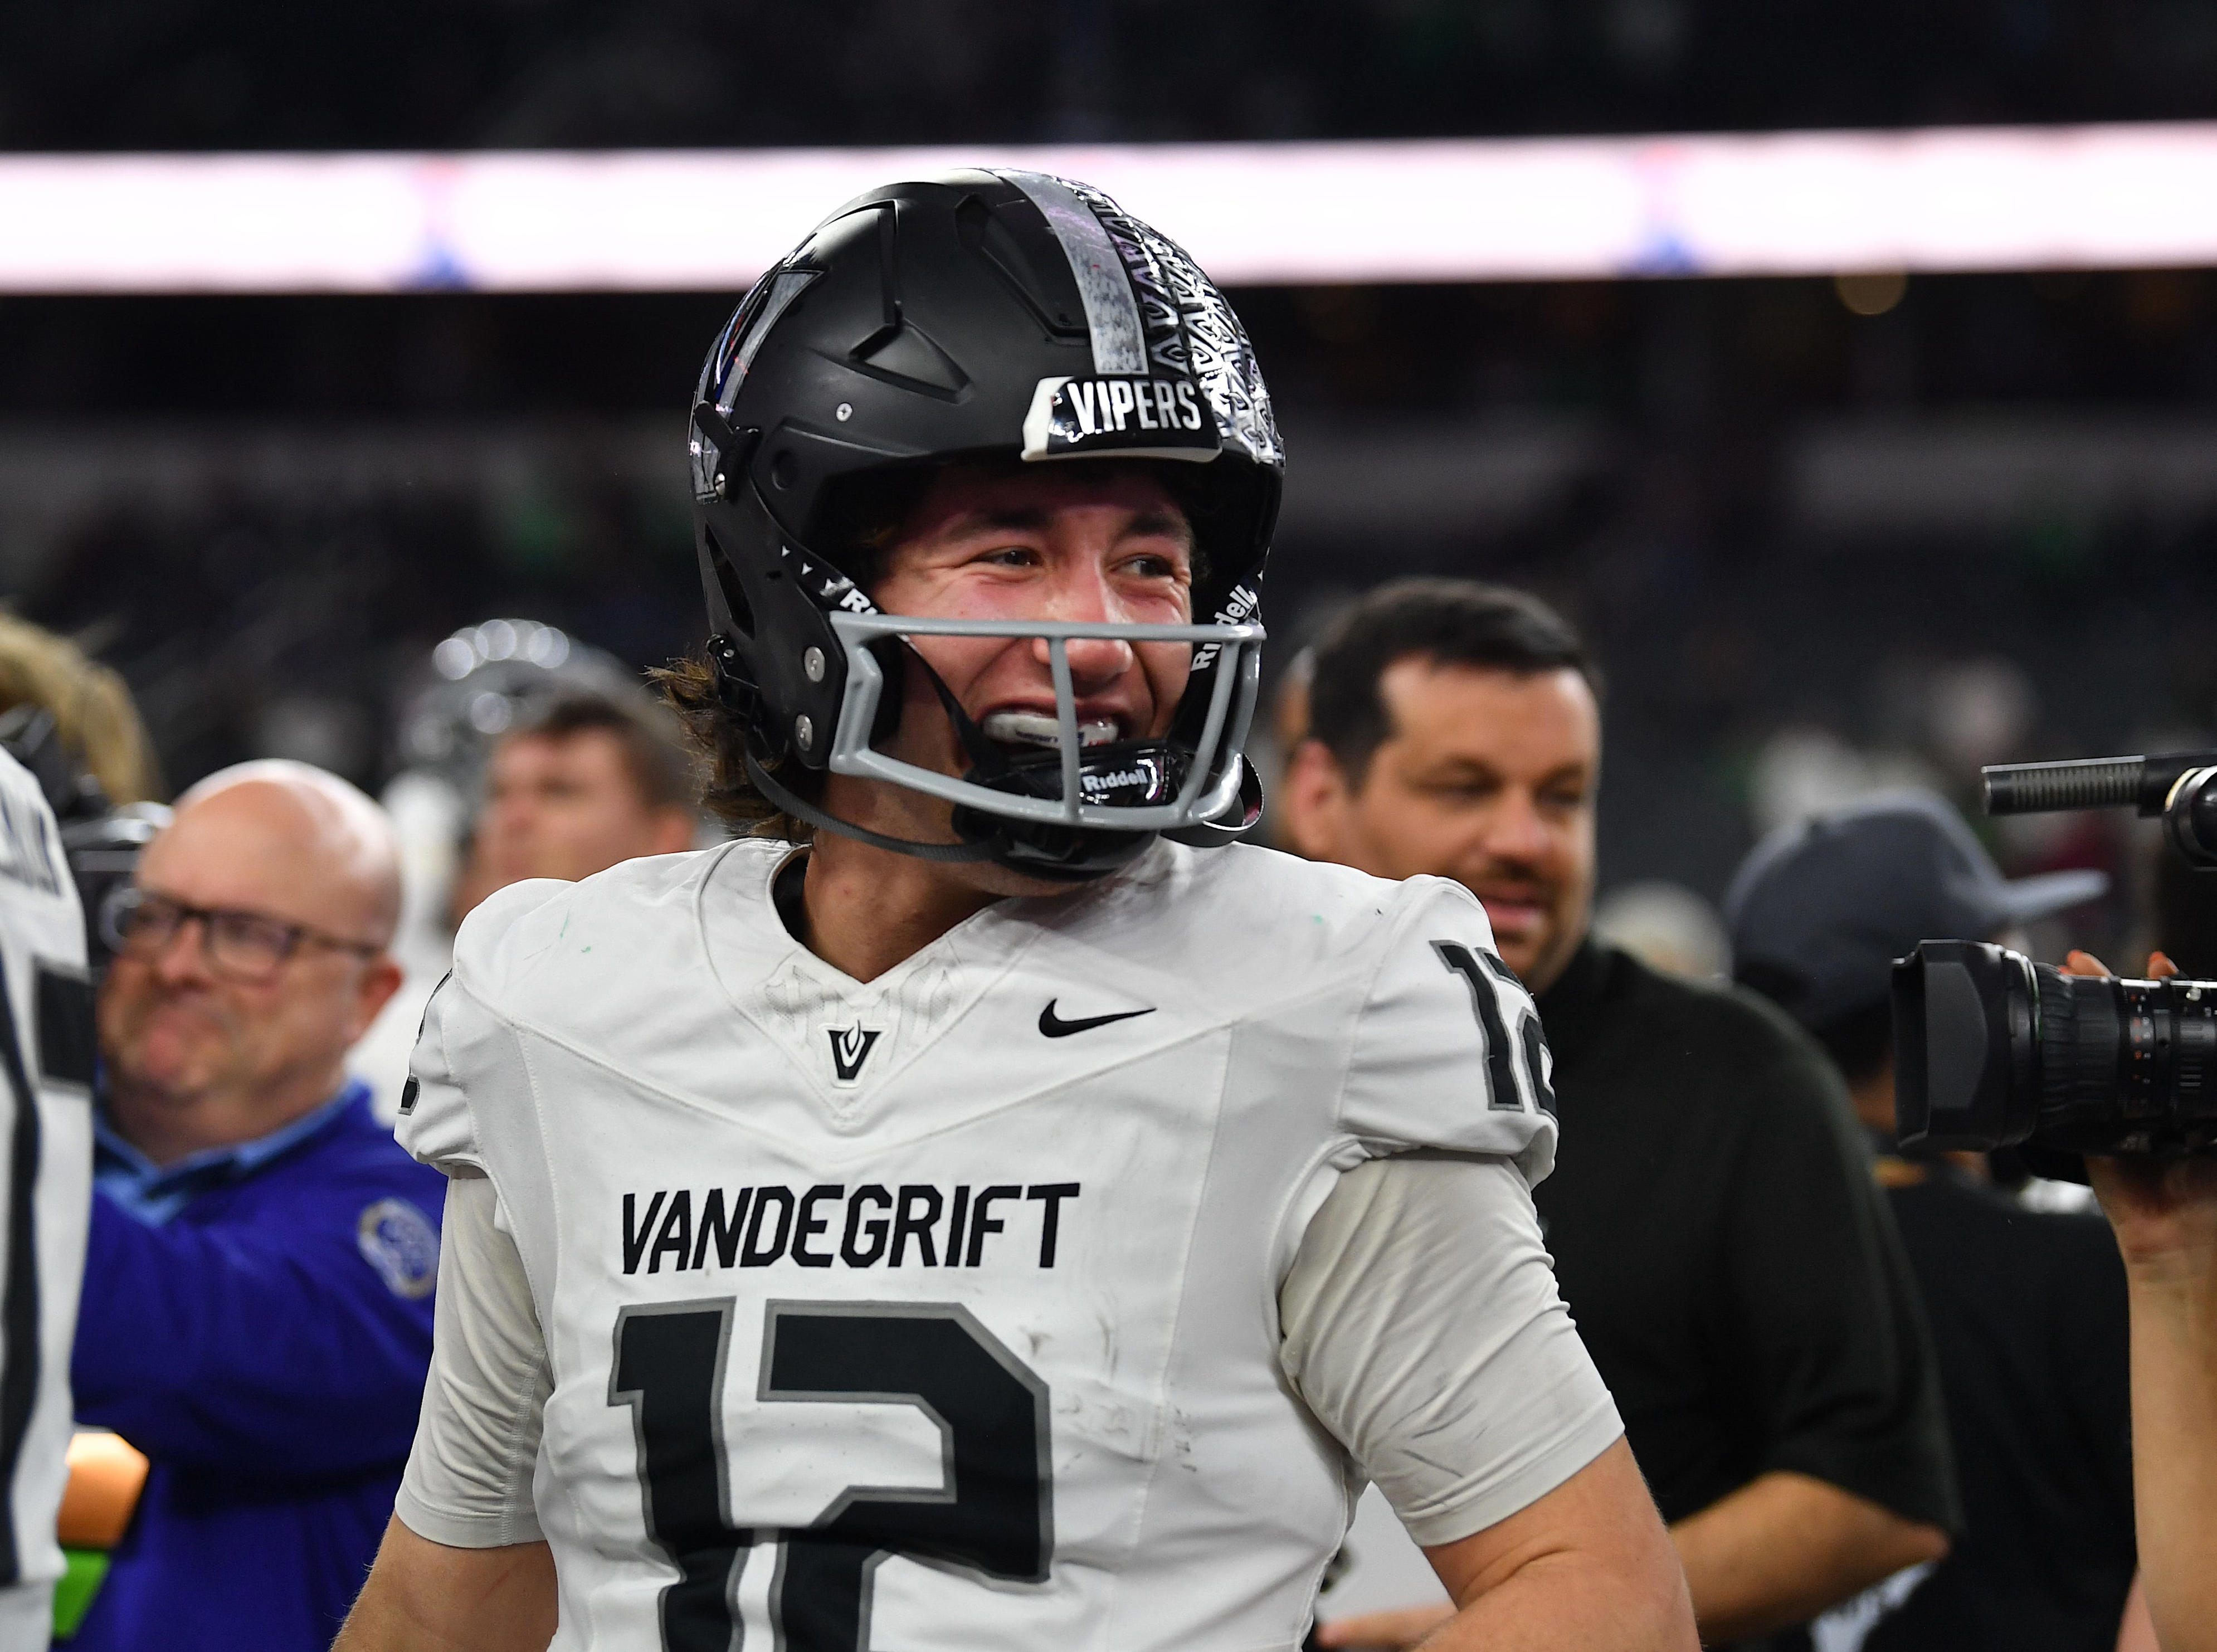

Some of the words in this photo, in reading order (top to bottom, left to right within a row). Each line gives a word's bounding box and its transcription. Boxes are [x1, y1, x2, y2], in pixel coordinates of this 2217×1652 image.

[1067, 380, 1201, 434] VIPERS
[1191, 584, 1258, 671] Ridell
[1082, 768, 1148, 792] Riddell
[622, 1183, 1080, 1275] VANDEGRIFT
[607, 1296, 1055, 1652] 12
